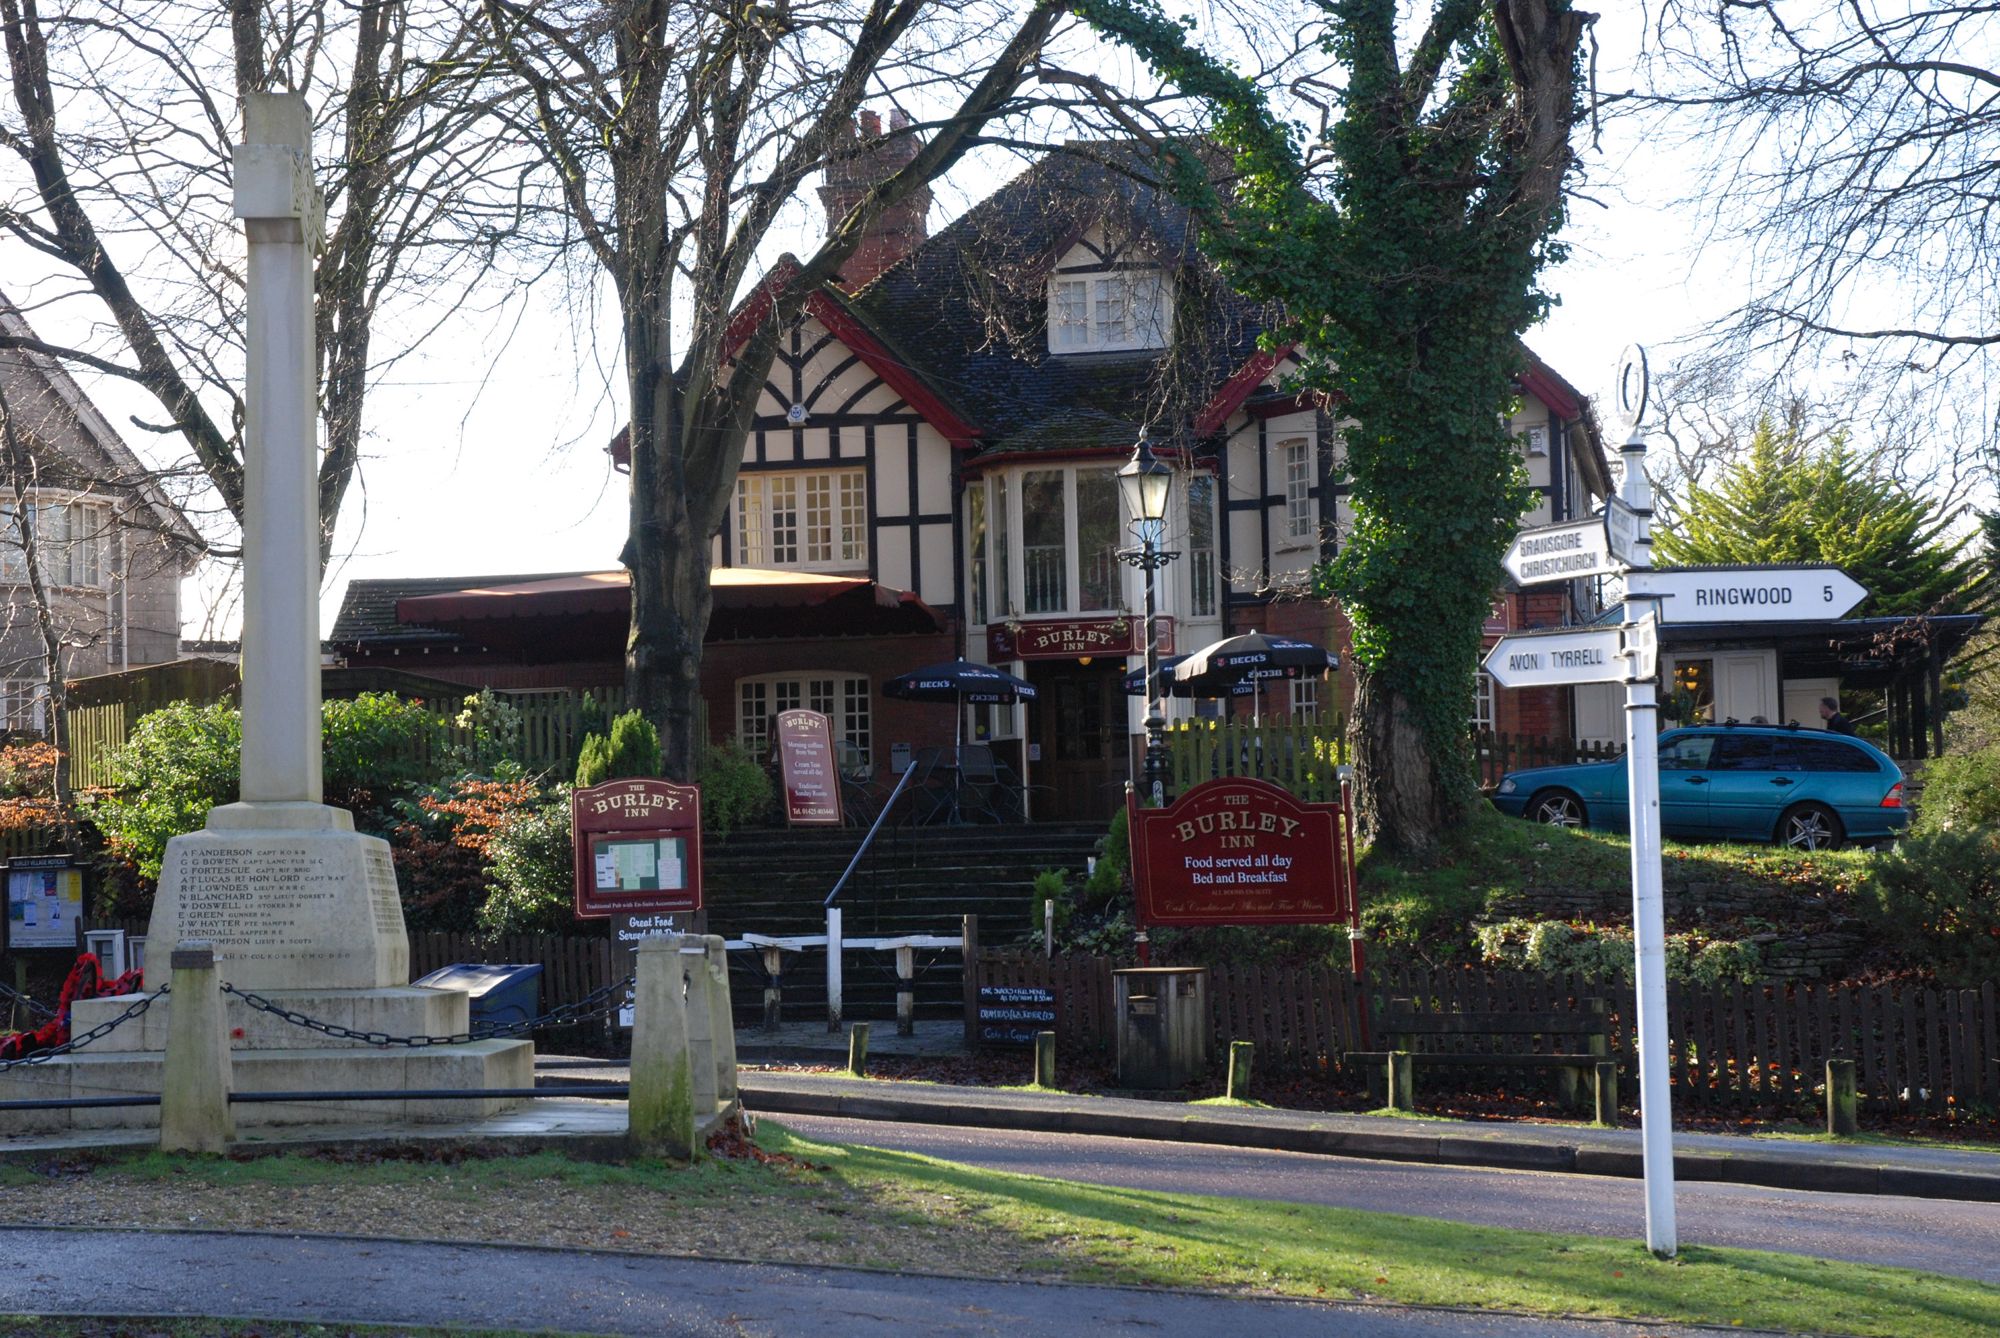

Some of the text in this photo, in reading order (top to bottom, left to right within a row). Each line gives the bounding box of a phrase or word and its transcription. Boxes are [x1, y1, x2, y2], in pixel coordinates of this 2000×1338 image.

[1520, 533, 1582, 557] BRANSGORE
[1520, 552, 1598, 579] CHRISTCHURCH
[1696, 586, 1833, 606] RINGWOOD 5
[1037, 630, 1110, 648] BURLEY
[1063, 642, 1085, 651] INN
[1229, 653, 1266, 665] BECK'S
[1509, 648, 1602, 671] AVON TYRRELL
[919, 680, 950, 689] BECK'S
[787, 718, 820, 729] BURLEY
[593, 793, 680, 815] BURLEY
[1223, 795, 1250, 806] THE
[625, 808, 650, 817] INN
[1176, 810, 1300, 842] BURLEY
[1220, 835, 1256, 848] INN
[199, 848, 253, 857] ANDERSON
[203, 858, 239, 866] BOWEN
[1184, 854, 1293, 870] Food served all day
[191, 866, 251, 875] FORTESCUE
[273, 874, 300, 882] LORD
[1192, 870, 1288, 884] Bed and Breakfast
[198, 884, 249, 892] LOWNDES
[190, 893, 253, 901] BLANCHARD
[189, 911, 224, 919] GREEN
[200, 919, 240, 927] HAYTER
[629, 916, 673, 928] Great Food
[187, 929, 236, 937] KENDALL
[618, 929, 646, 941] Served
